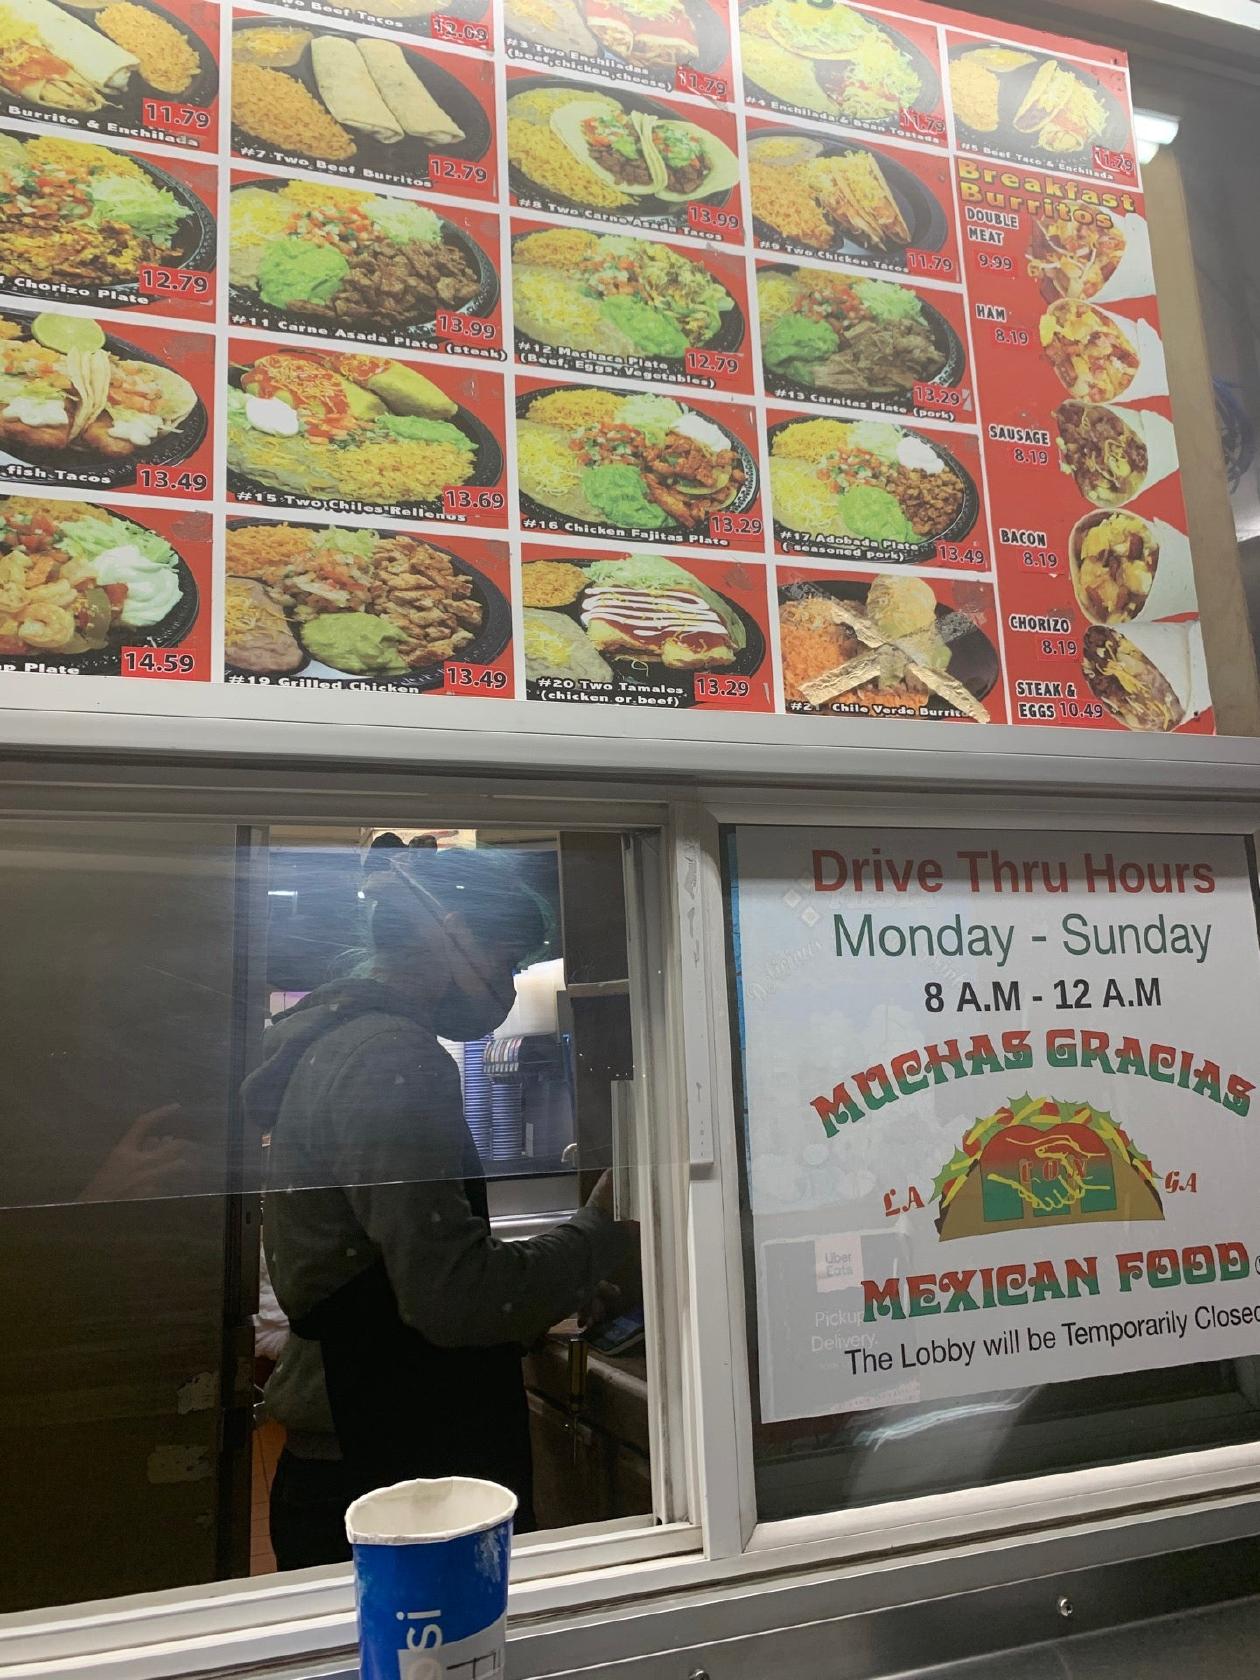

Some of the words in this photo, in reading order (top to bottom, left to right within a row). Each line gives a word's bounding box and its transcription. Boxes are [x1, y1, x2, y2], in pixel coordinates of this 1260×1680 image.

[358, 10, 402, 27] Tacos
[506, 37, 529, 49] #3
[535, 42, 565, 57] Two
[571, 48, 649, 75] Enchiladas
[8, 105, 80, 126] Burrito
[86, 119, 100, 130] &
[107, 122, 199, 147] Enchilada
[144, 103, 211, 129] 11.79
[771, 101, 836, 121] Enchilada
[890, 127, 940, 144] Tostada
[240, 147, 265, 158] #7
[274, 151, 310, 166] Two
[316, 160, 356, 175] Beef
[362, 168, 433, 188] Burritos
[430, 159, 488, 183] 12.79
[983, 147, 1011, 159] Beef
[1016, 153, 1040, 165] Taco
[1058, 162, 1114, 180] Enchilada
[957, 158, 1136, 213] Breakfast
[960, 181, 1114, 230] Burritos
[519, 198, 542, 210] #8
[547, 202, 579, 216] Two
[584, 210, 628, 226] Carne
[631, 218, 677, 233] Asada
[682, 227, 723, 241] Tacos
[689, 206, 740, 230] 13.99
[966, 207, 1019, 229] DOUBLE
[969, 227, 1003, 244] MEAT
[759, 240, 781, 251] #9
[785, 244, 814, 257] Two
[817, 250, 869, 267] Chicken
[873, 260, 910, 273] Tacos
[907, 253, 953, 272] 11.79
[979, 254, 1013, 270] 9.99
[14, 277, 90, 297] Chorizo
[98, 289, 150, 305] Plate
[142, 269, 209, 293] 12.79
[976, 304, 1007, 322] HAM
[231, 314, 269, 328] #11
[278, 320, 328, 336] Carne
[335, 328, 388, 344] Asada
[394, 336, 439, 351] Plate
[446, 343, 507, 361] (steak)
[438, 314, 497, 339] 13.99
[995, 329, 1028, 345] 8.19
[518, 341, 553, 353] #12
[558, 346, 623, 364] Machaca
[627, 356, 668, 370] Plate
[687, 352, 739, 374] 12.79
[520, 352, 569, 369] (Beef,
[575, 360, 619, 375] Eggs,
[624, 366, 716, 389] Vegetables)
[775, 389, 805, 400] #13
[810, 394, 867, 409] Carnitas
[871, 402, 907, 414] Plate
[912, 407, 955, 422] (pork)
[914, 386, 961, 406] 13.29
[989, 425, 1050, 446] SAUSAGE
[1014, 448, 1048, 464] 8.19
[6, 466, 47, 478] fish
[54, 470, 112, 485] Tacos
[140, 468, 208, 492] 13.49
[237, 492, 277, 504] #15
[284, 495, 320, 508] Two
[328, 500, 383, 514] Chiles
[445, 489, 505, 509] 13.69
[523, 518, 558, 531] #16
[565, 522, 626, 537] Chicken
[631, 528, 683, 543] Fajitas
[689, 534, 729, 547] Plate
[710, 516, 763, 535] 13.29
[780, 531, 811, 541] #17
[816, 534, 879, 547] Adobada
[883, 540, 919, 550] Plate
[1000, 528, 1047, 547] BACON
[866, 551, 904, 561] pork)
[938, 545, 985, 564] 13.49
[1023, 552, 1058, 567] 8.19
[1010, 615, 1071, 633] CHORIZO
[1042, 640, 1077, 655] 8.19
[25, 662, 80, 675] Plate
[124, 652, 195, 675] 14.59
[228, 675, 271, 686] #19
[278, 677, 343, 691] Grilled
[349, 681, 420, 694] Chicken
[446, 667, 507, 689] 13.49
[538, 677, 574, 689] #20
[579, 680, 613, 691] Two
[618, 682, 683, 694] Tamales
[696, 678, 749, 697] 13.29
[540, 690, 609, 703] (chicken
[614, 695, 632, 704] or
[637, 695, 680, 708] beef)
[1016, 681, 1061, 697] STEAK
[1066, 682, 1076, 698] &
[832, 703, 868, 713] Chile
[871, 704, 915, 715] Verde
[1019, 703, 1055, 718] EGGS
[1060, 702, 1104, 718] 10.49
[812, 848, 944, 893] Drive
[957, 850, 1069, 894] Thru
[1085, 853, 1216, 895] Hours
[832, 912, 1015, 968] Monday
[1031, 934, 1047, 942] -
[1062, 913, 1212, 964] Sunday
[924, 981, 945, 1014] 8
[956, 980, 1020, 1013] A.M
[1053, 978, 1092, 1009] 12
[1102, 976, 1162, 1008] A.M
[810, 1030, 1034, 1138] MUCHAS
[1045, 1028, 1257, 1118] GRACIAS
[861, 1256, 1100, 1323] MEXICAN
[1115, 1241, 1250, 1292] FOOD
[844, 1347, 893, 1376] The
[901, 1336, 976, 1369] Lobby
[983, 1329, 1019, 1357] will
[1027, 1326, 1057, 1352] be
[1062, 1305, 1188, 1348] Temporarily
